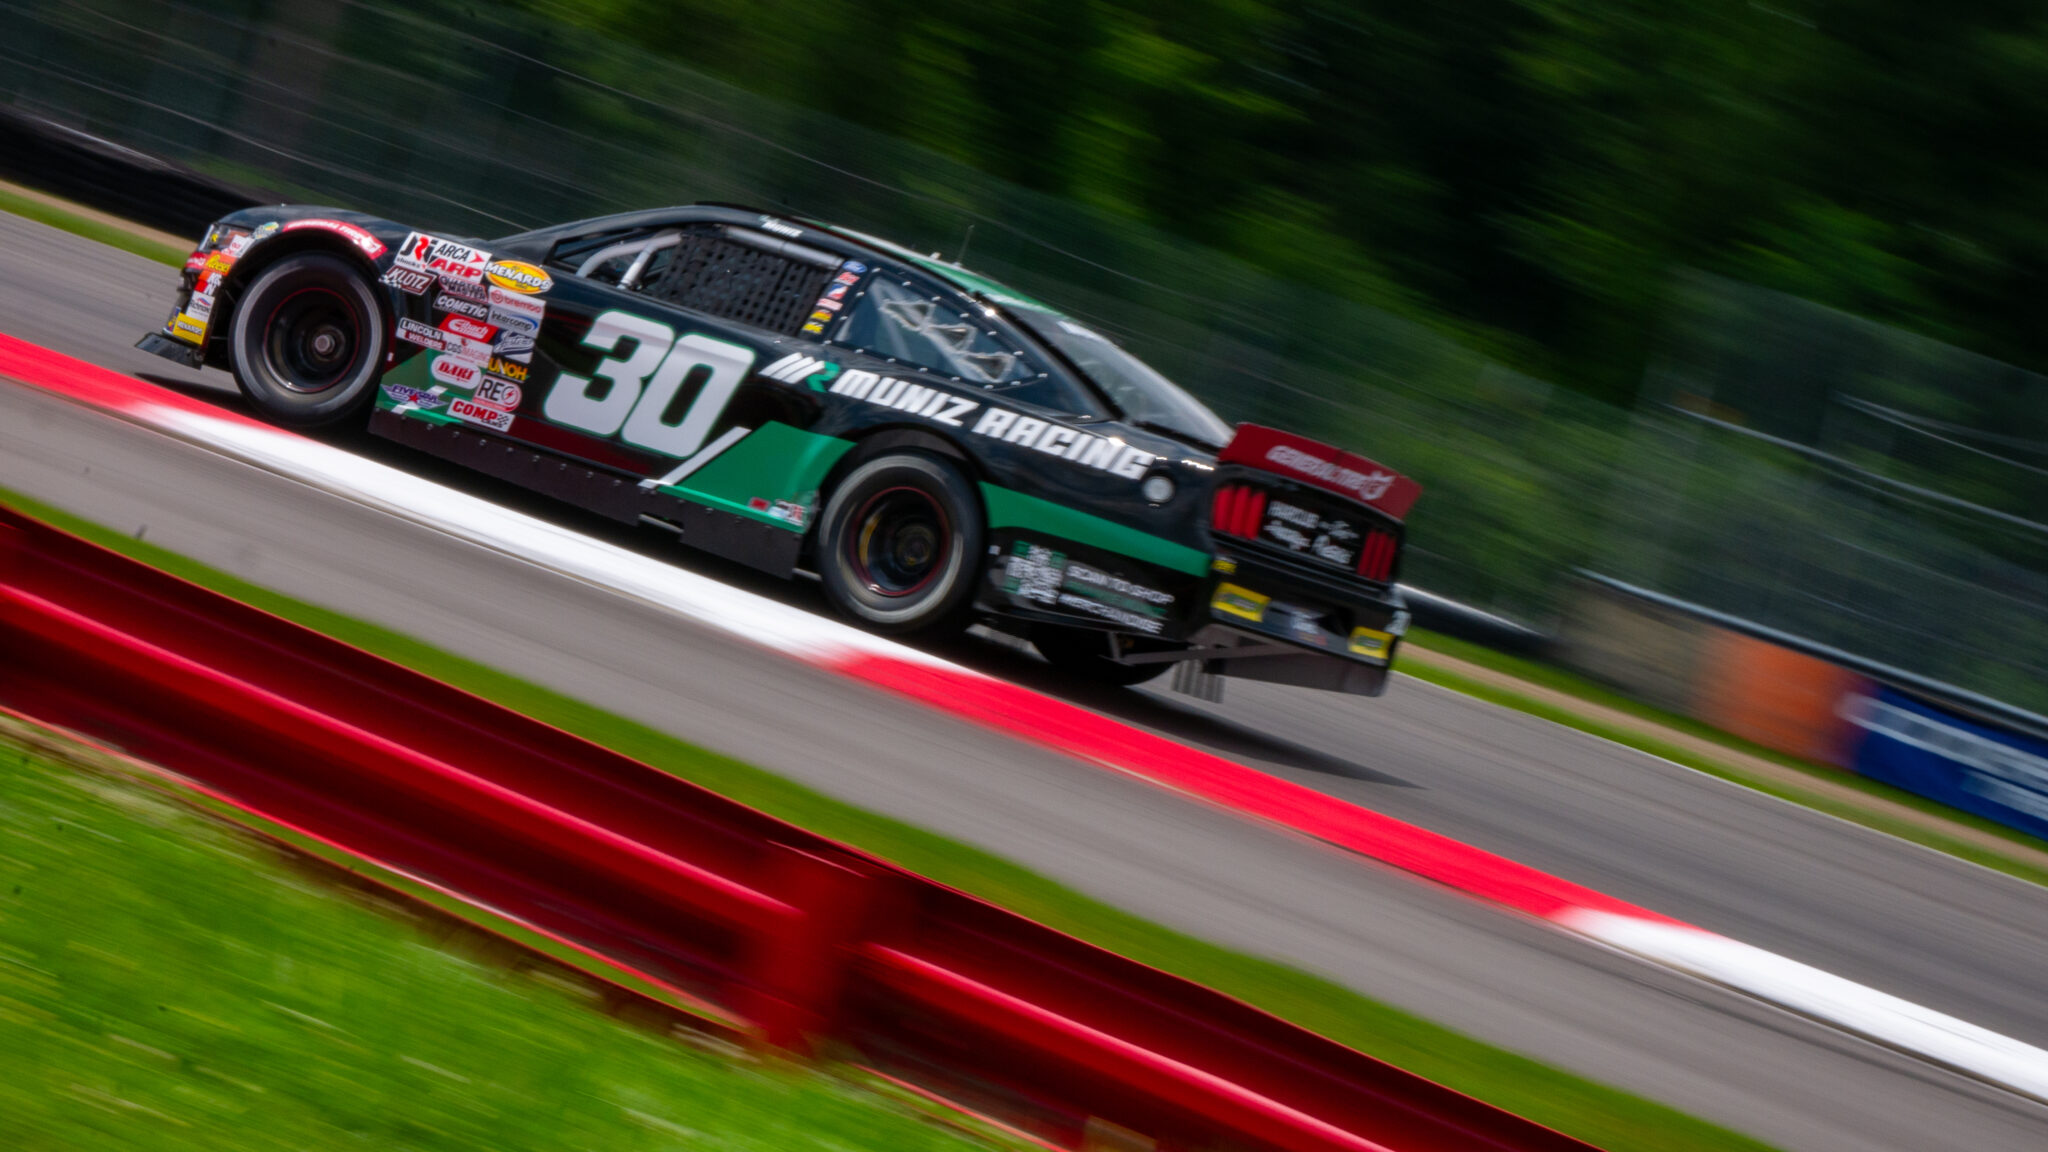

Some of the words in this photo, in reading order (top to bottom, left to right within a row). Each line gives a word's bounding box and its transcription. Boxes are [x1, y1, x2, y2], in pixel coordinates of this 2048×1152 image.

[435, 243, 471, 262] ARCA
[389, 267, 431, 290] KLOTZ
[429, 258, 482, 278] ARP
[484, 262, 553, 291] MENARDS
[437, 294, 488, 317] COMETIC
[504, 297, 541, 314] brembo
[402, 320, 442, 341] LINCOLN
[487, 357, 528, 381] UNOH
[543, 309, 757, 460] 30
[452, 400, 498, 422] COMP
[828, 368, 981, 428] MUNIZ
[971, 407, 1157, 481] RACING
